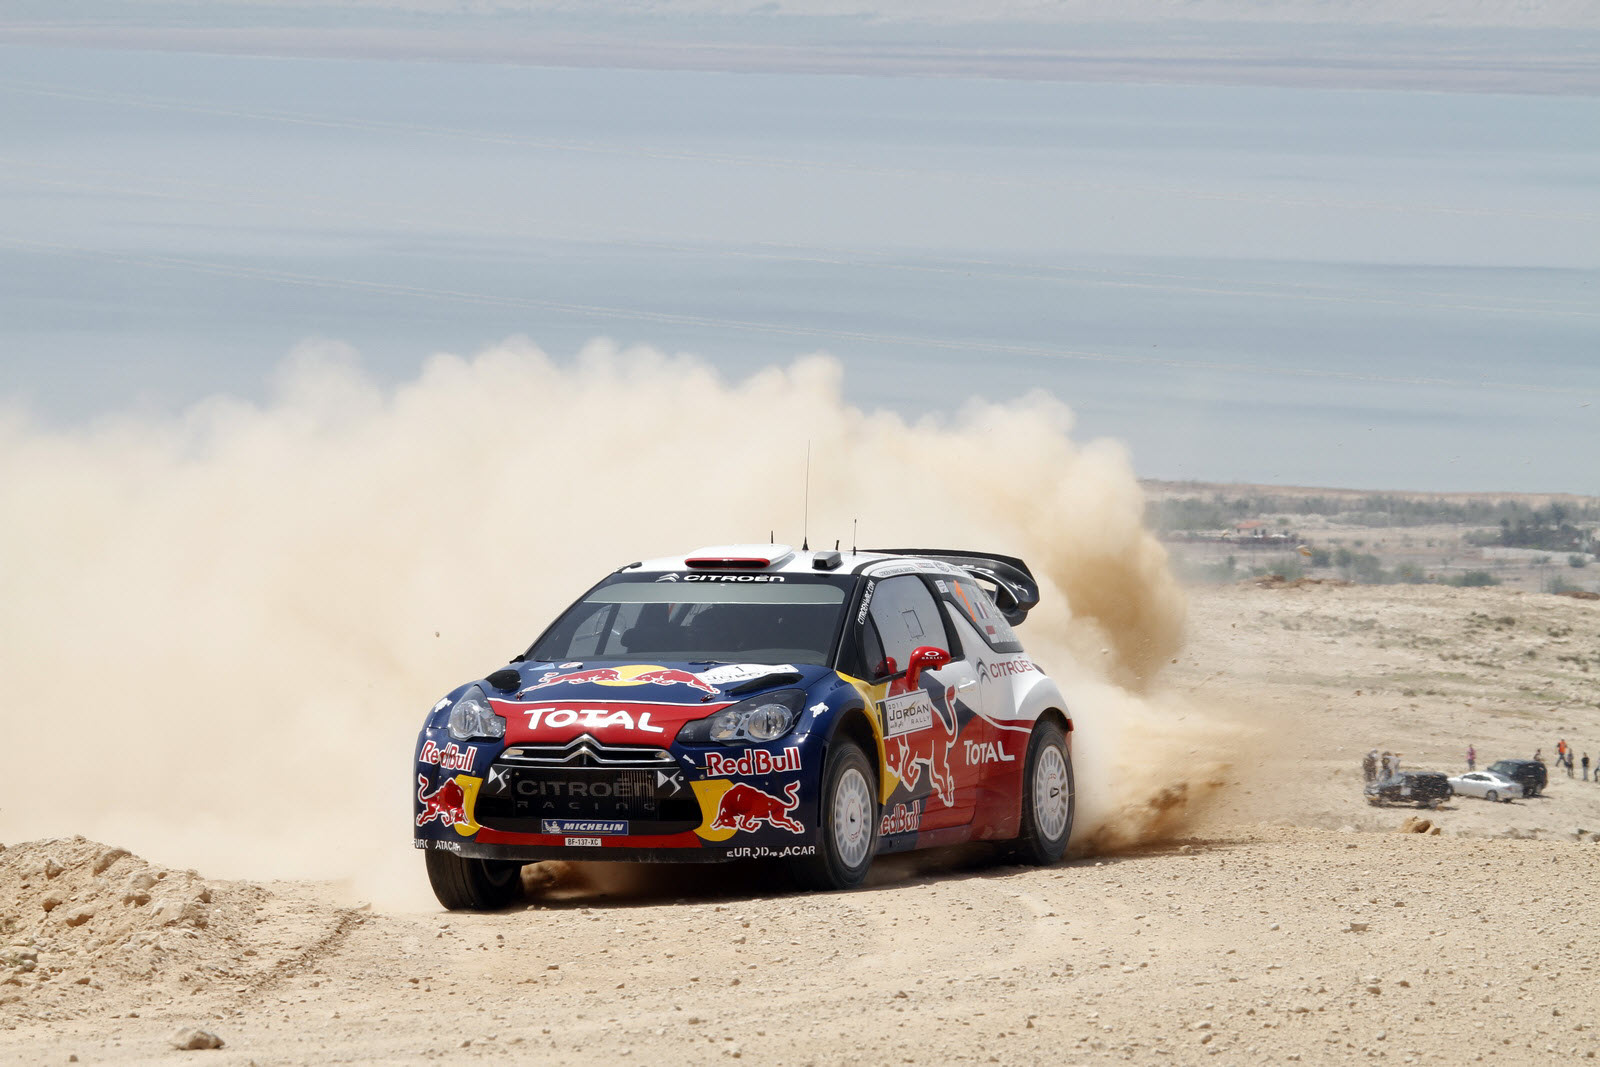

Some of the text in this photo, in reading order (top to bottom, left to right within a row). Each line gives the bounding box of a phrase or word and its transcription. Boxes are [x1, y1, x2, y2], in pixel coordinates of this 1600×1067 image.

[889, 703, 930, 721] JORDAN
[523, 707, 665, 733] TOTAL
[910, 715, 931, 724] RALLY
[963, 740, 1016, 766] TOTAL
[563, 822, 625, 832] MICHELIN
[567, 838, 599, 846] BF-137-XC
